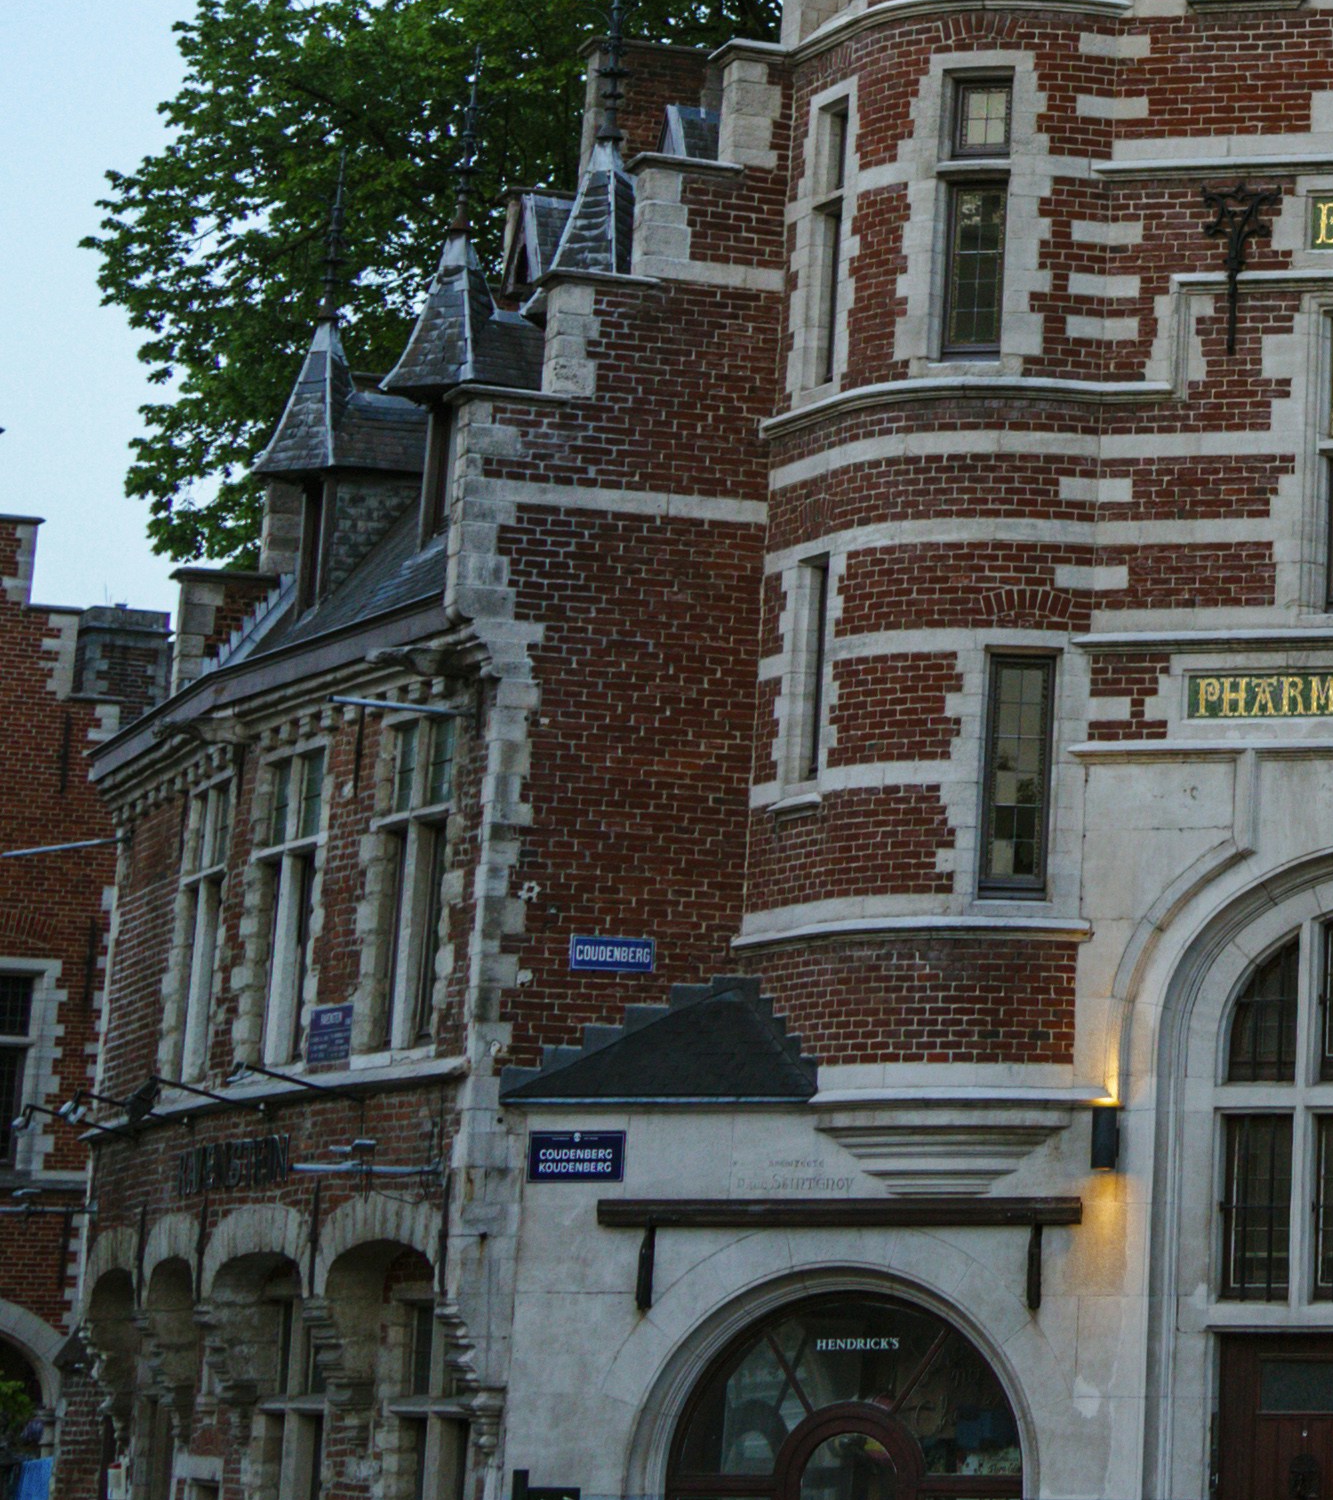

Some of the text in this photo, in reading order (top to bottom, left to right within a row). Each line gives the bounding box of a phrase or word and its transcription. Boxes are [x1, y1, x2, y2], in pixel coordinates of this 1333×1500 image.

[576, 944, 651, 963] COUDENBERG
[539, 1148, 613, 1160] COUDENBERG
[538, 1161, 612, 1173] KOUDENBERG
[816, 1337, 900, 1351] HENDRICK'S
